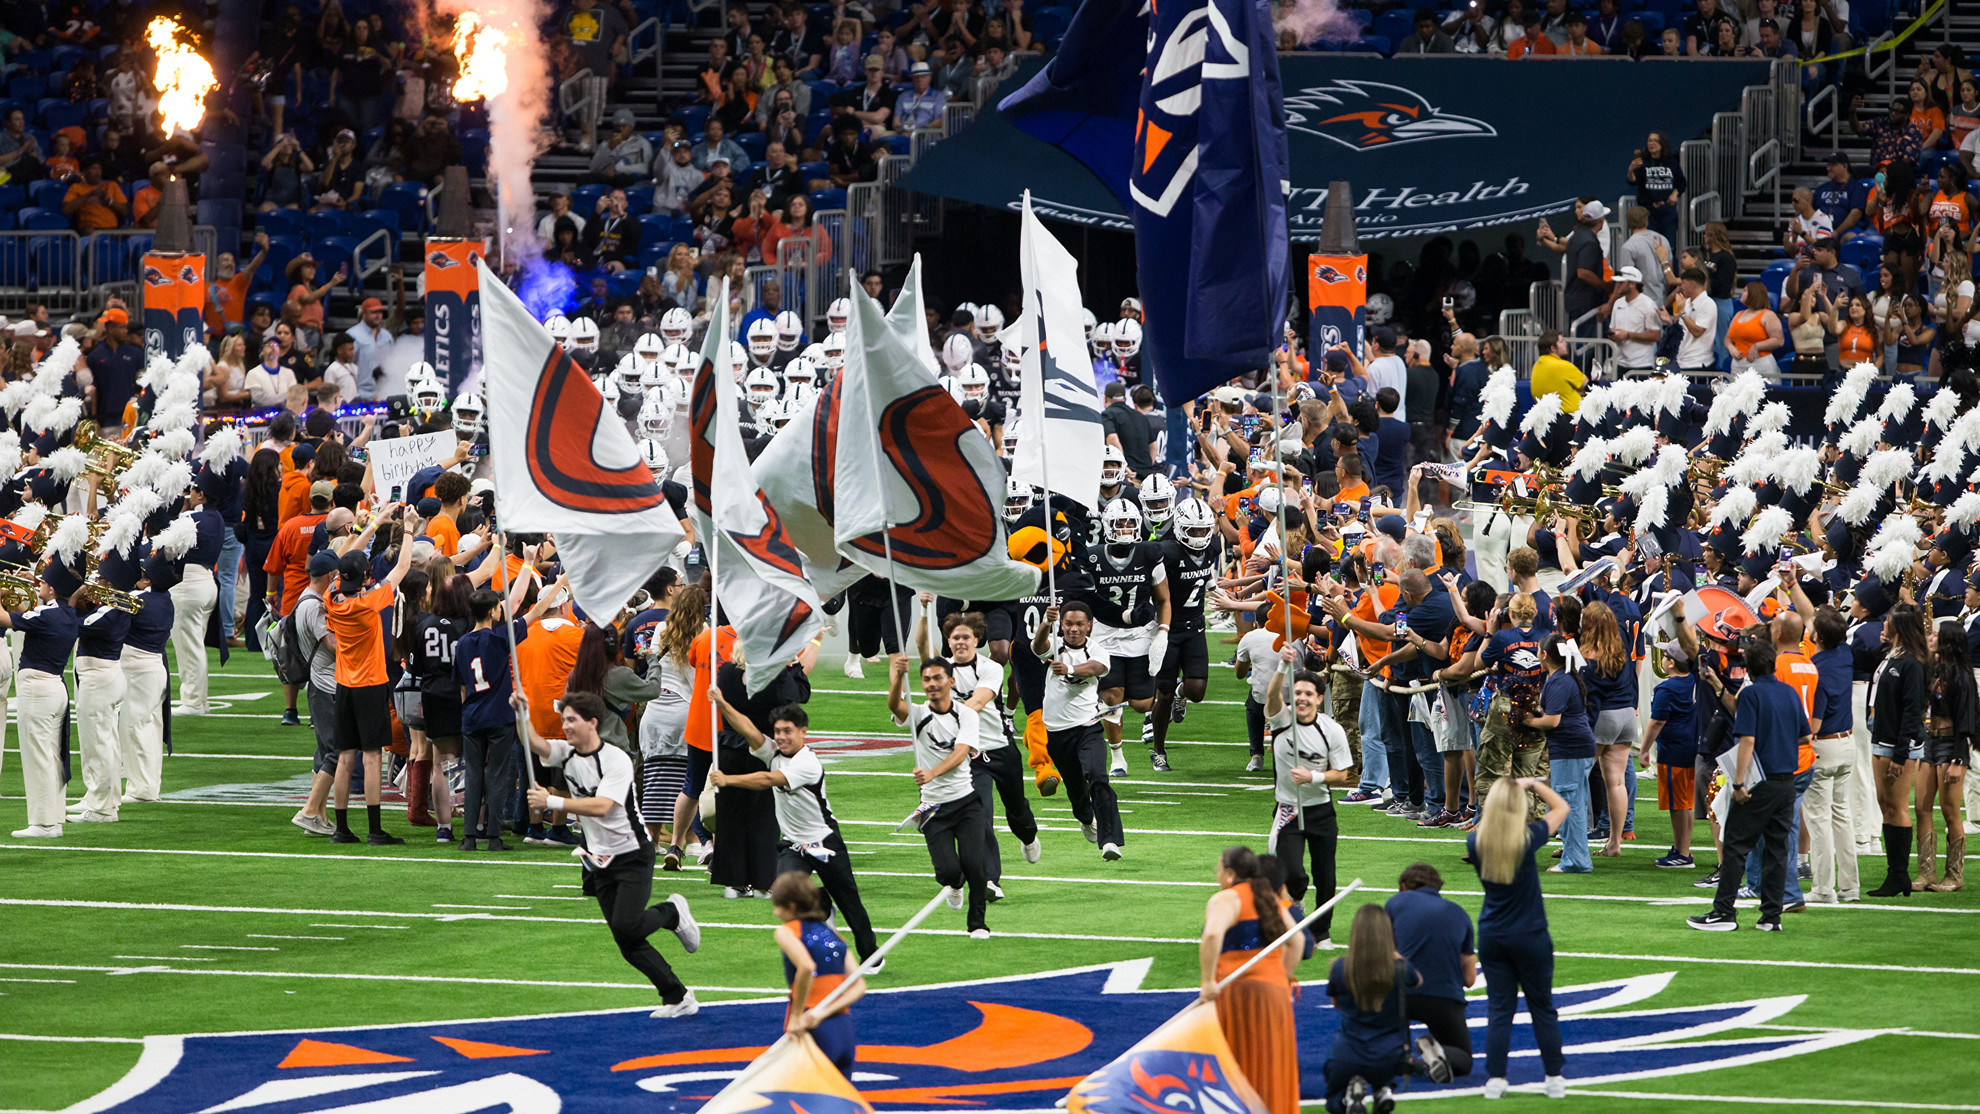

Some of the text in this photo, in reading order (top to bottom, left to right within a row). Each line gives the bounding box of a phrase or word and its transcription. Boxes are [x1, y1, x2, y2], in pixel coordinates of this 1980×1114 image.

[1645, 167, 1673, 178] UTSA
[1354, 176, 1530, 211] Health
[1290, 213, 1398, 225] Annio
[1391, 224, 1458, 238] UTSA
[1464, 205, 1571, 230] Athletics
[1851, 337, 1859, 353] 1
[389, 436, 436, 458] happy
[381, 456, 437, 481] birthday
[1099, 574, 1146, 585] RUNNERS
[1180, 567, 1212, 580] RUNNE
[1183, 579, 1205, 607] 2
[470, 656, 491, 692] 1
